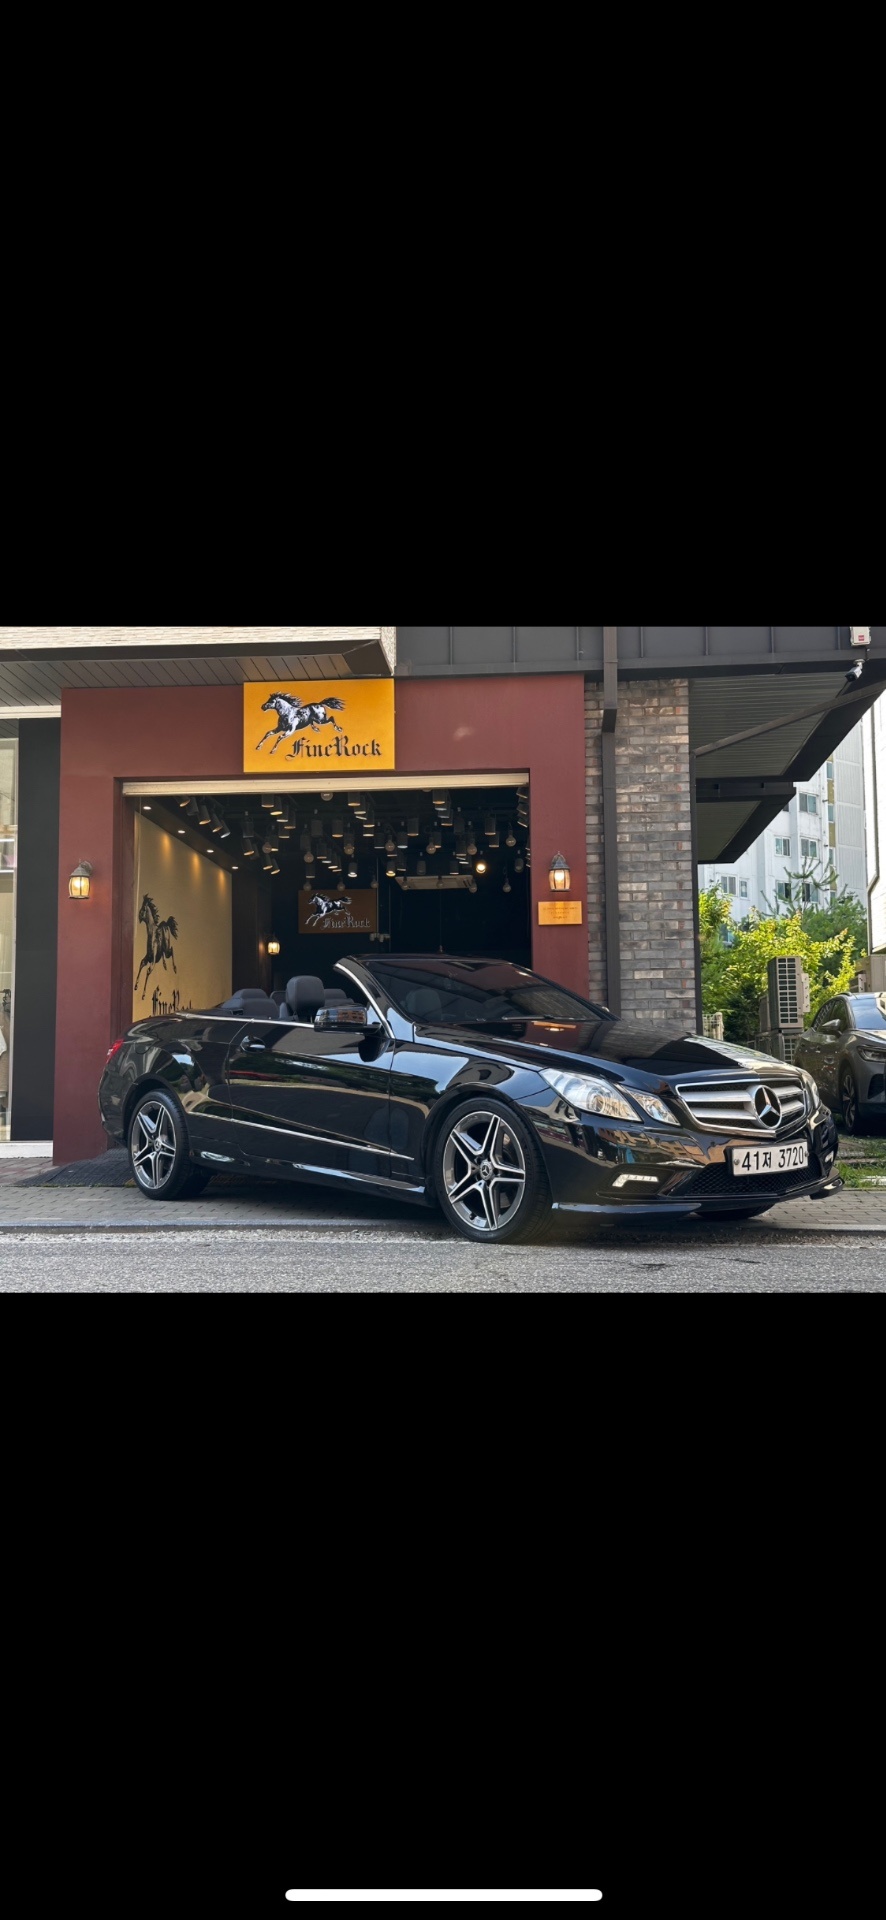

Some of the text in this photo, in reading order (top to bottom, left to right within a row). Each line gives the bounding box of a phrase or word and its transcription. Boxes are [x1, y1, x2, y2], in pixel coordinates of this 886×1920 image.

[285, 735, 383, 761] FineRock
[320, 915, 371, 930] FineRock
[742, 1145, 804, 1171] 41저 3720
